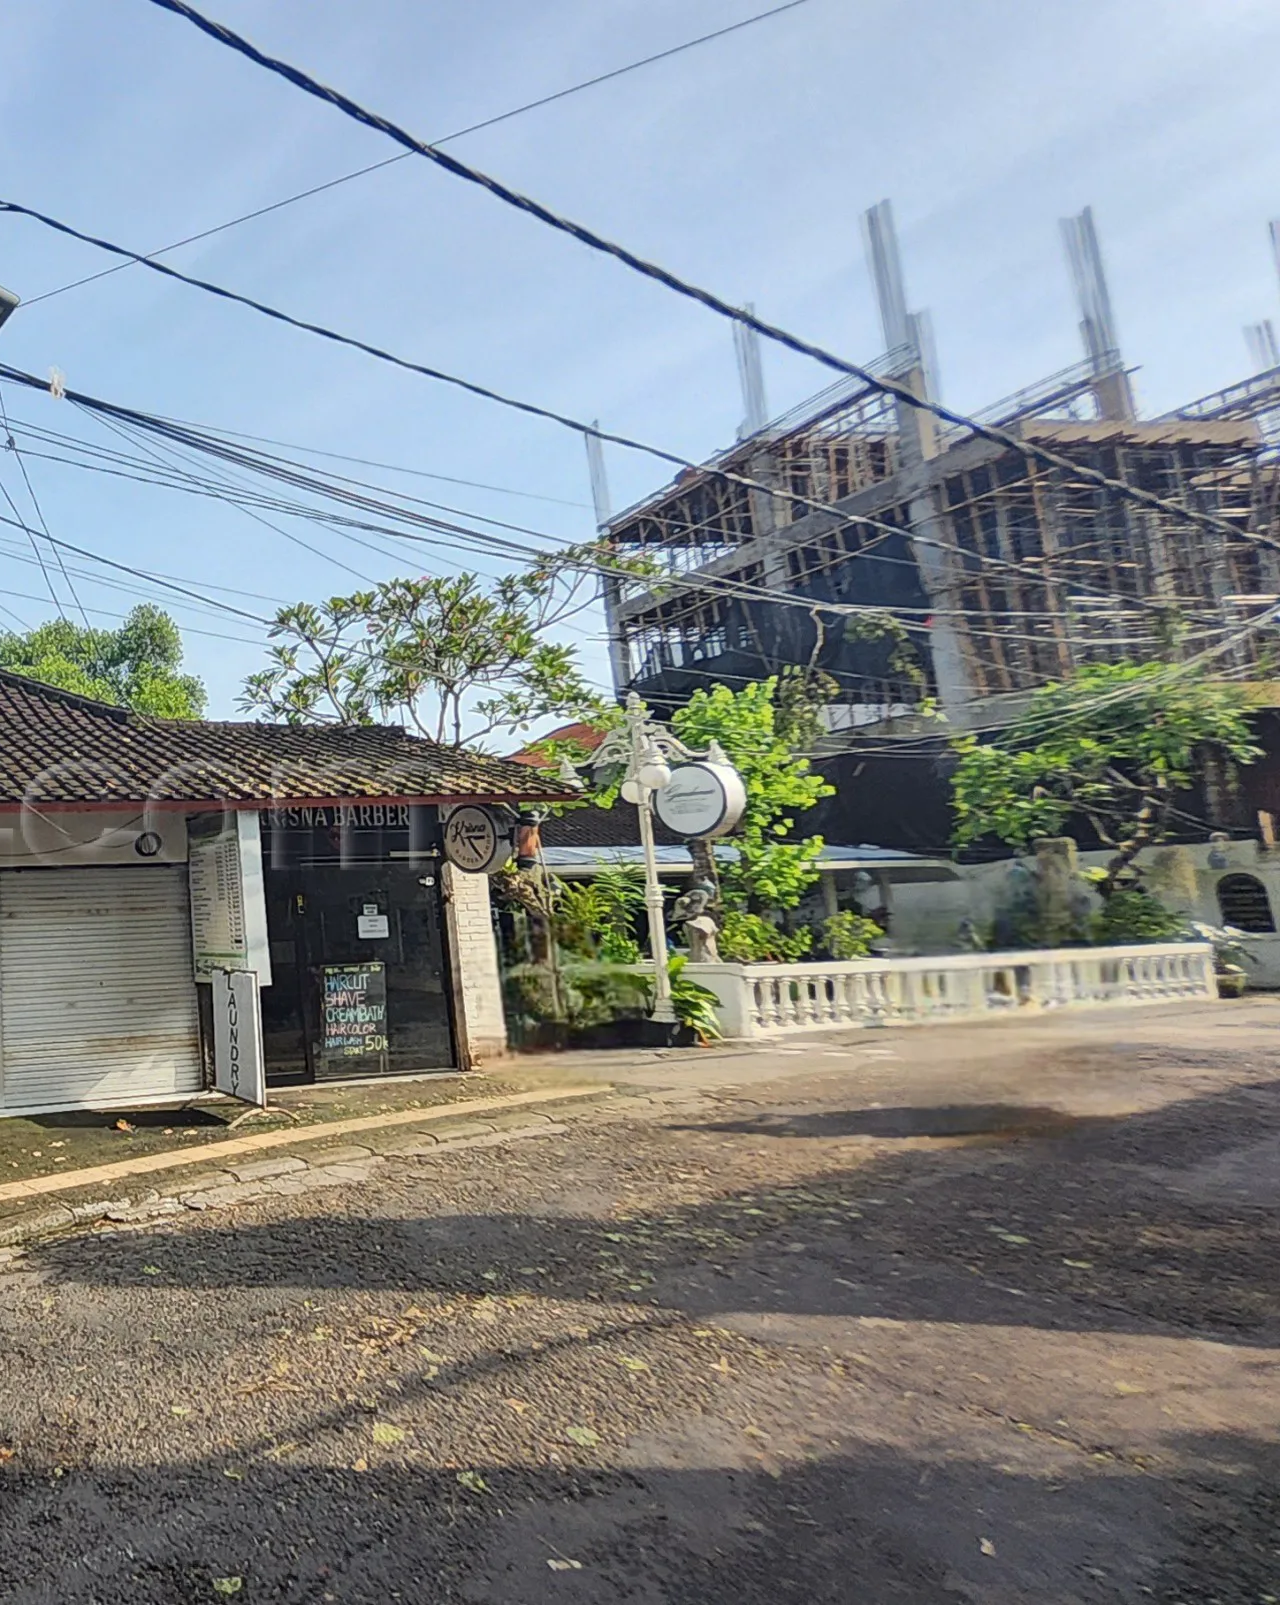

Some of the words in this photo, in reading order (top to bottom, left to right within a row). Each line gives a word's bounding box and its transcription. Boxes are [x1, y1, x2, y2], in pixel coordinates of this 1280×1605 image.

[333, 805, 410, 827] BARBER
[324, 973, 370, 992] HAIRCUT
[324, 991, 366, 1007] SHAVE
[325, 1005, 385, 1023] CREAMBATH
[227, 973, 239, 1096] LAUNDRY
